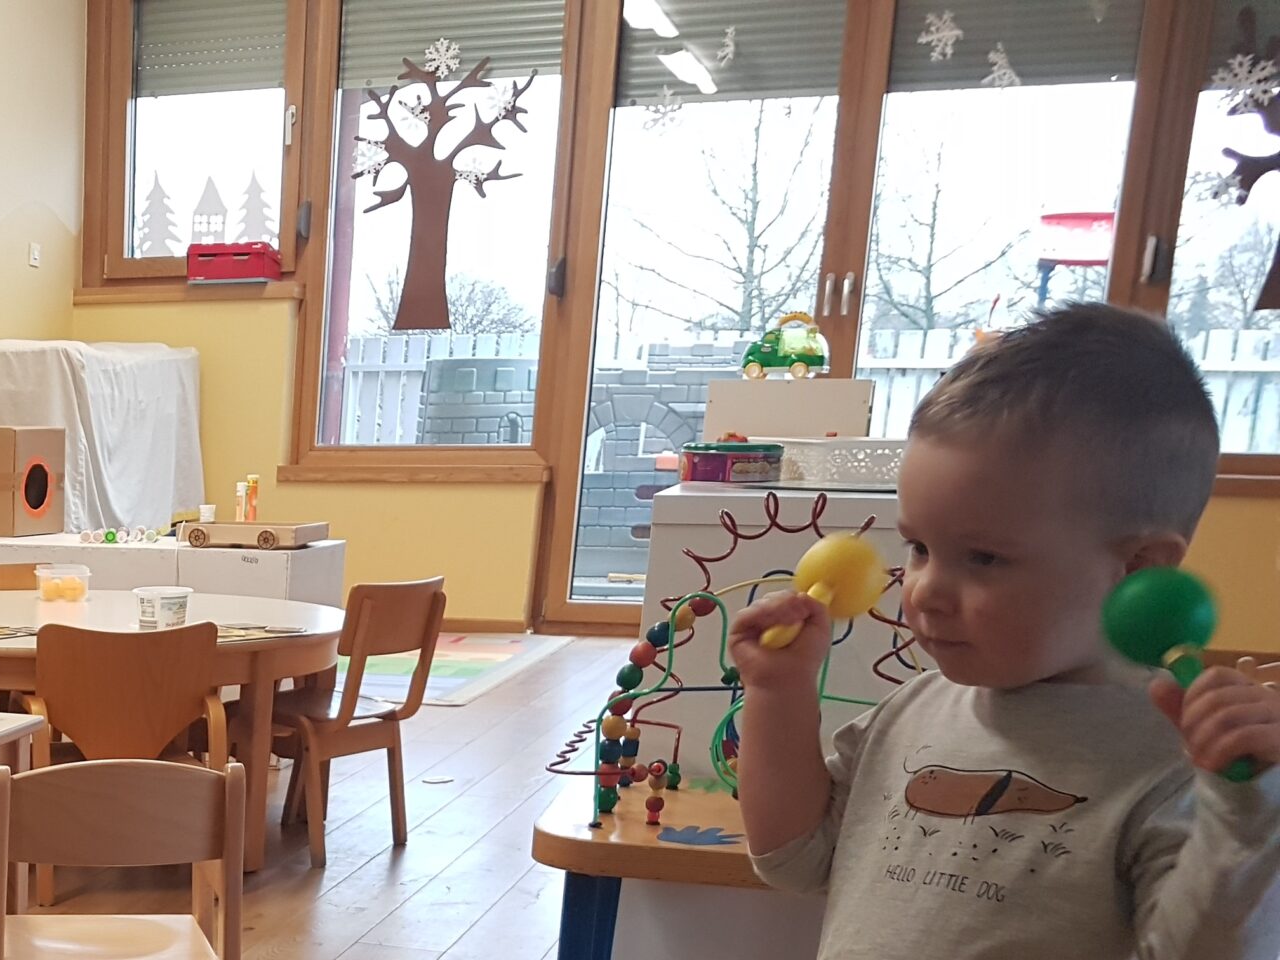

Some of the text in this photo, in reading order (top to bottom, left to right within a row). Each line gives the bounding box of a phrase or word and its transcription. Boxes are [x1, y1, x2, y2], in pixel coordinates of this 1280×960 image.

[885, 864, 1006, 902] HELLO LITTLE DOG
